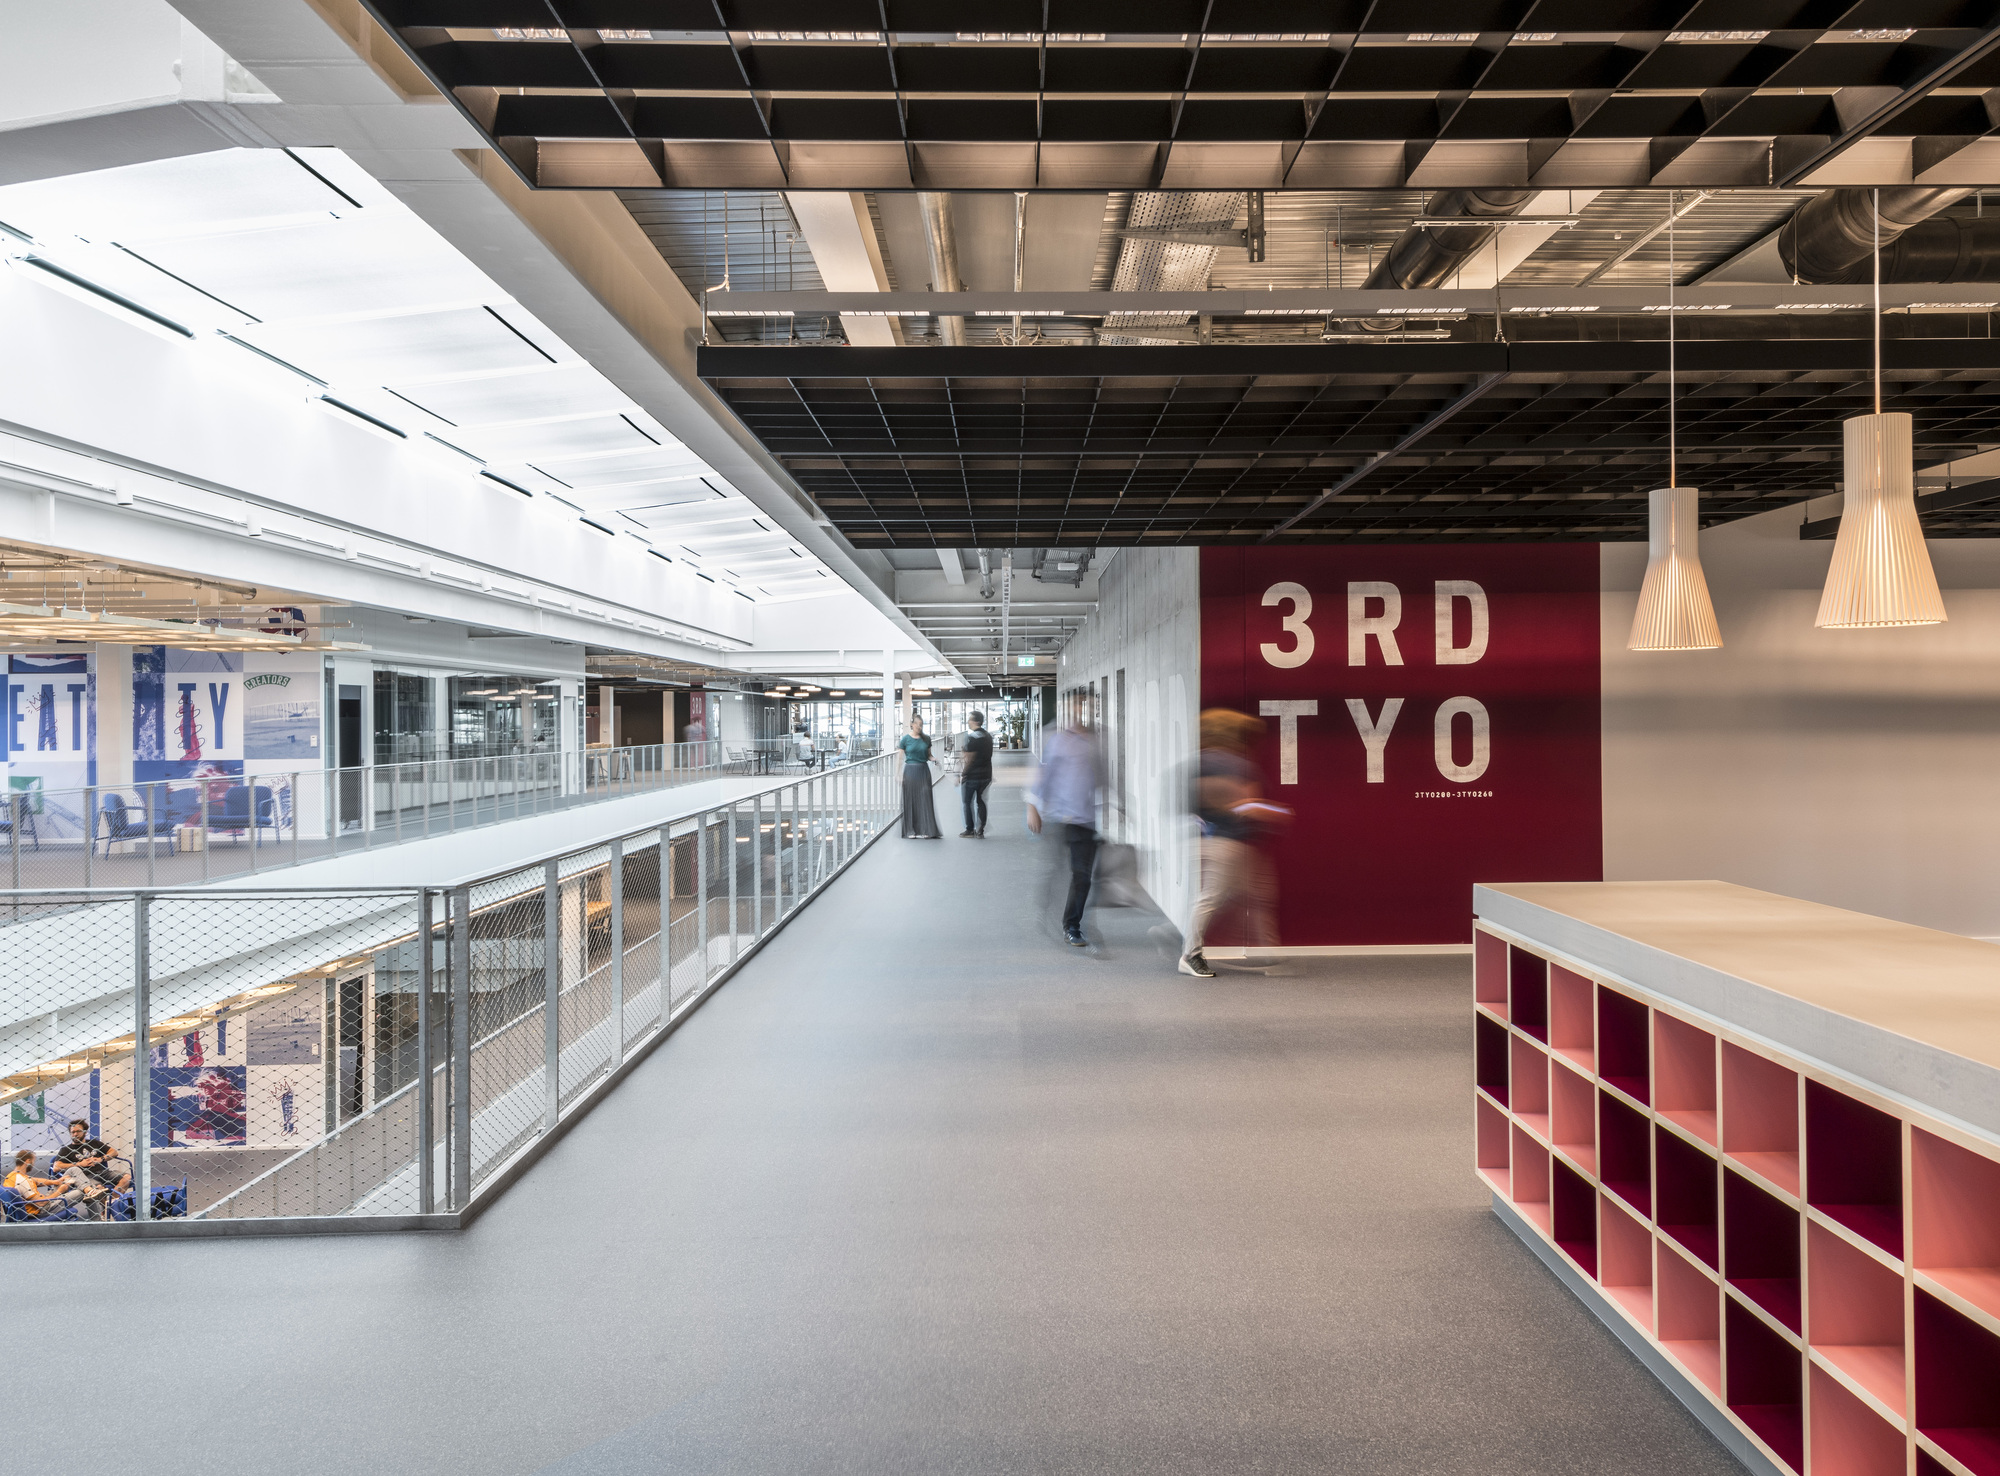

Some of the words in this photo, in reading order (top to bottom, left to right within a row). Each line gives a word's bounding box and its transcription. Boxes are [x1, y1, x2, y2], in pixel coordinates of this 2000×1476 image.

[1259, 579, 1490, 669] 3RD
[244, 674, 289, 689] CREATORS
[1258, 695, 1491, 785] TYO
